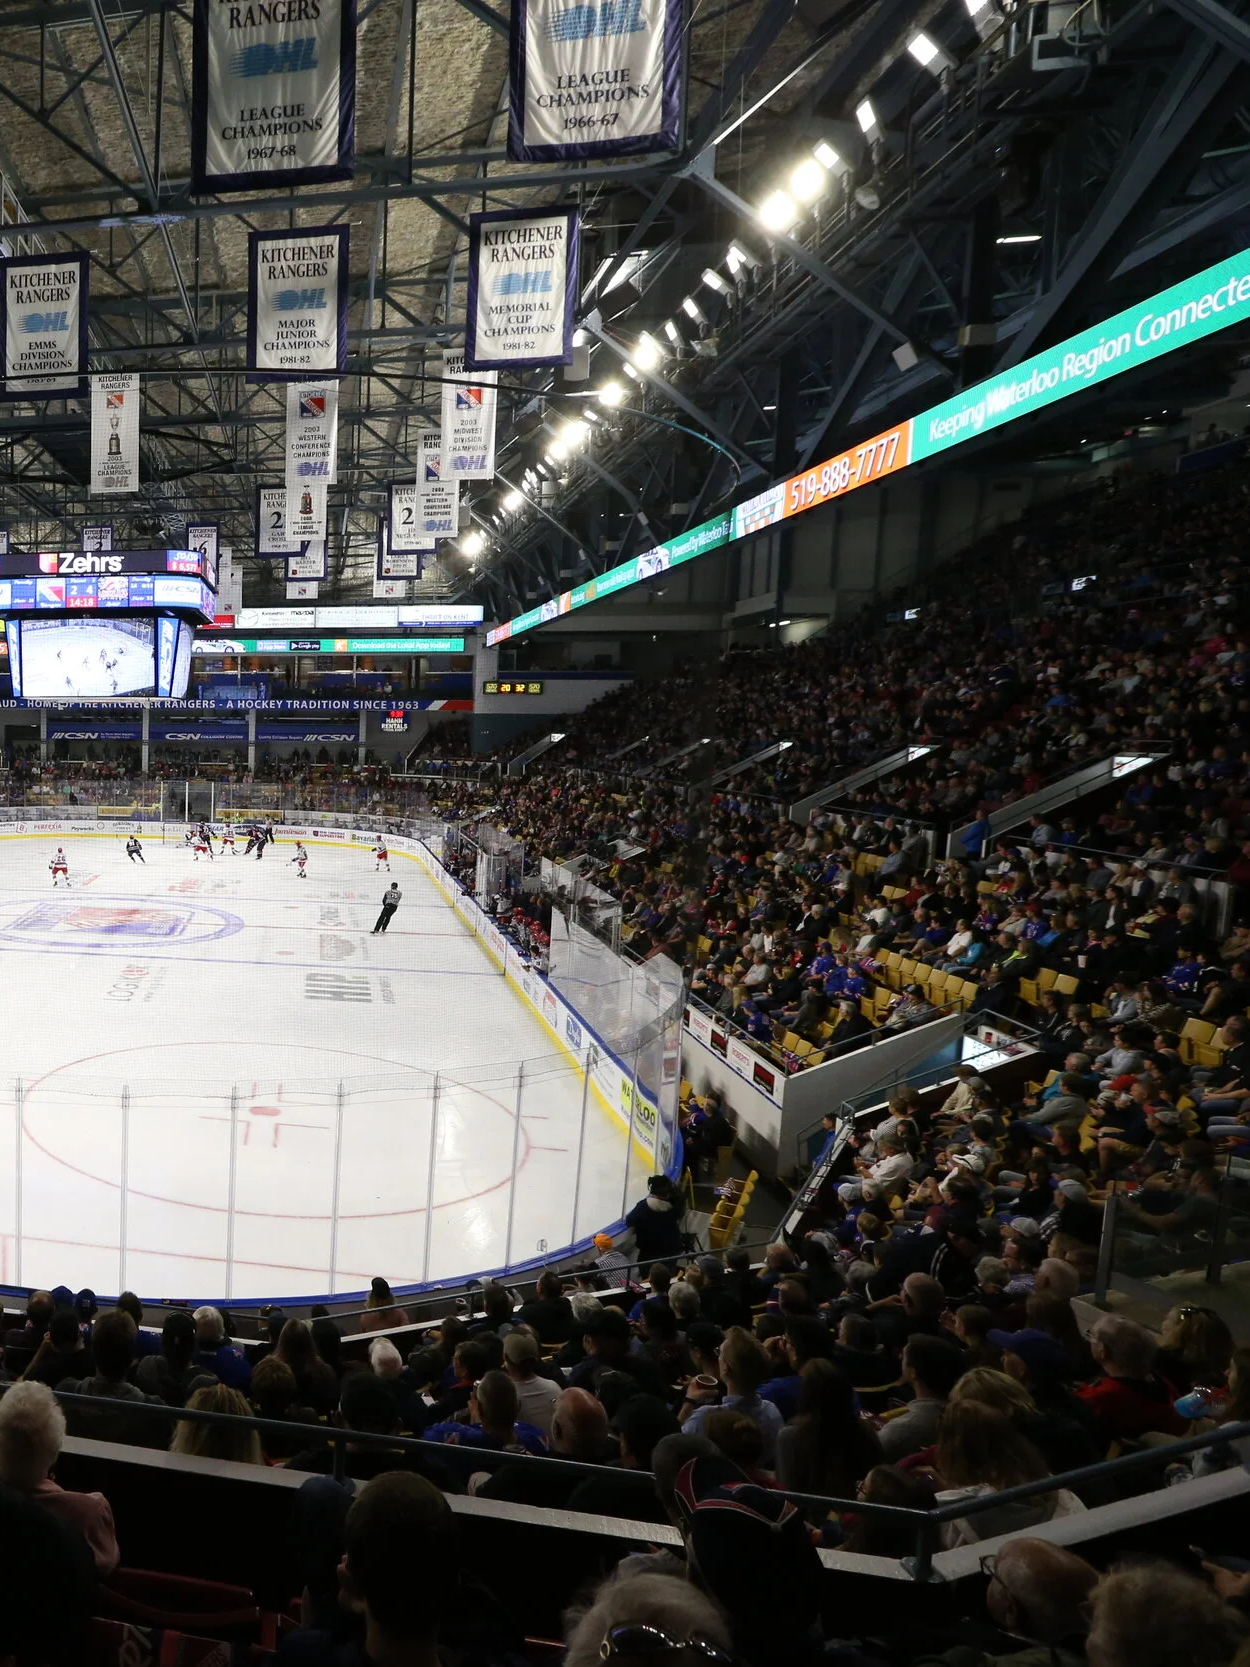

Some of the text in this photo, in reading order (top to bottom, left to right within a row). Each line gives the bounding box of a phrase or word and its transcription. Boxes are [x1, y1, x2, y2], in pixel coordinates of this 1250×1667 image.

[228, 2, 321, 30] RANGERS
[556, 68, 630, 90] LEAGUE
[536, 84, 650, 109] CHAMPIONS
[239, 104, 305, 122] LEAGUE
[564, 113, 618, 130] 1966-67
[221, 117, 323, 141] CHAMPIONS
[247, 144, 296, 160] 1967-68
[484, 225, 562, 246] KITCHENER
[261, 244, 334, 263] KITCHENER
[492, 244, 555, 262] RANGERS
[269, 262, 328, 280] RANGERS
[10, 270, 77, 289] KITCHENER
[16, 287, 70, 304] RANGERS
[488, 302, 552, 315] MEMORIAL
[278, 319, 315, 329] MAJOR
[508, 315, 532, 324] CUP
[276, 330, 317, 340] JUNIOR
[485, 324, 555, 337] CHAMPIONS
[28, 341, 57, 350] EMMS
[264, 340, 330, 351] CHAMPIONS
[503, 341, 535, 350] 1981-82
[20, 350, 65, 360] DIVISION
[280, 356, 310, 364] 1981-82
[12, 360, 72, 370] CHAMPIONS
[929, 333, 1131, 442] Keeping Waterloo Region
[291, 442, 331, 450] CONFERENCE
[791, 432, 901, 510] 519-888-7777
[59, 552, 122, 574] Zehrs
[70, 585, 94, 595] 2 4
[70, 598, 94, 607] 14:18
[353, 642, 382, 650] Download
[27, 700, 58, 708] HOME
[165, 700, 216, 708] RANGERS
[226, 701, 234, 709] A
[238, 700, 283, 709] HOCKEY
[286, 700, 350, 709] TRADITION
[353, 700, 387, 709] SINCE
[391, 701, 419, 710] 1963
[314, 734, 355, 742] CSN
[34, 822, 62, 830] PERFEXIA
[273, 828, 307, 836] Jamieson
